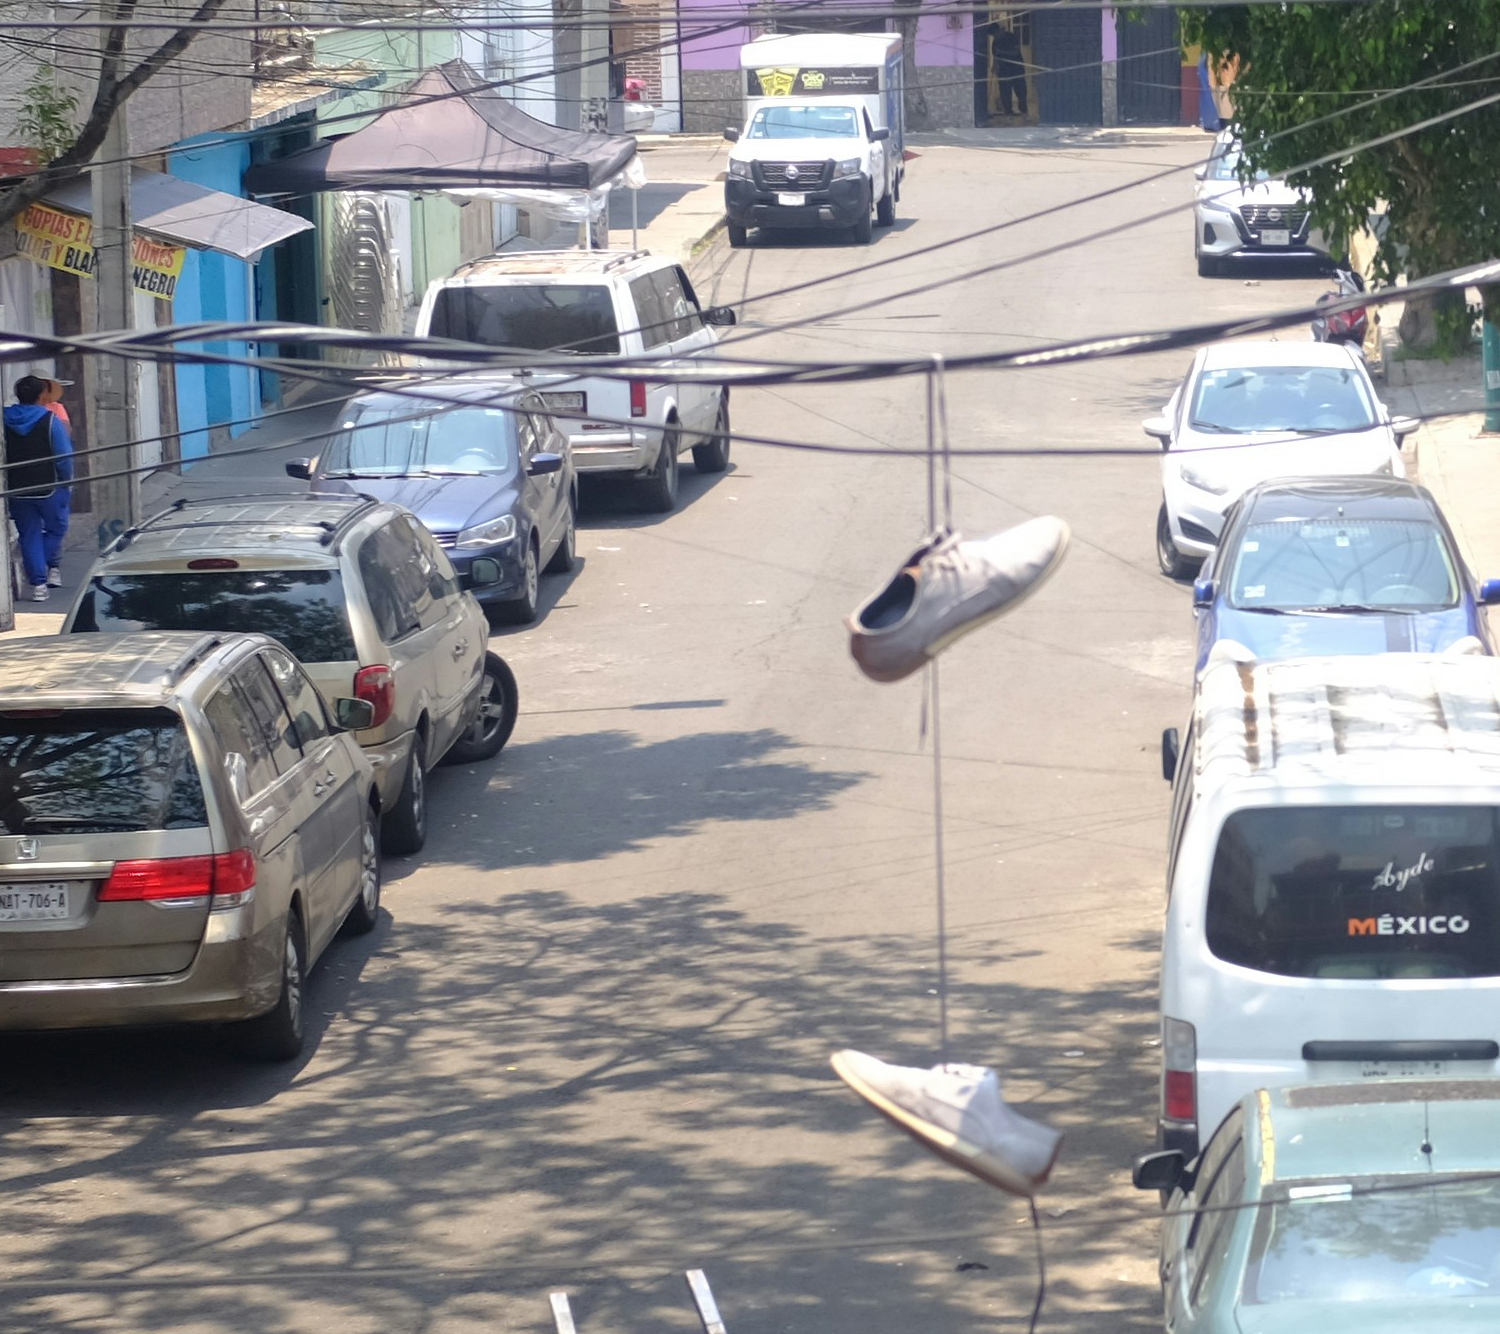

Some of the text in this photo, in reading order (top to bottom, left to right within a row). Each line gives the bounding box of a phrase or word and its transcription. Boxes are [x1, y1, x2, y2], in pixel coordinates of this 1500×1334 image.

[53, 242, 65, 264] Y
[133, 265, 177, 297] NEGRO
[1347, 913, 1470, 937] MÉXICO
